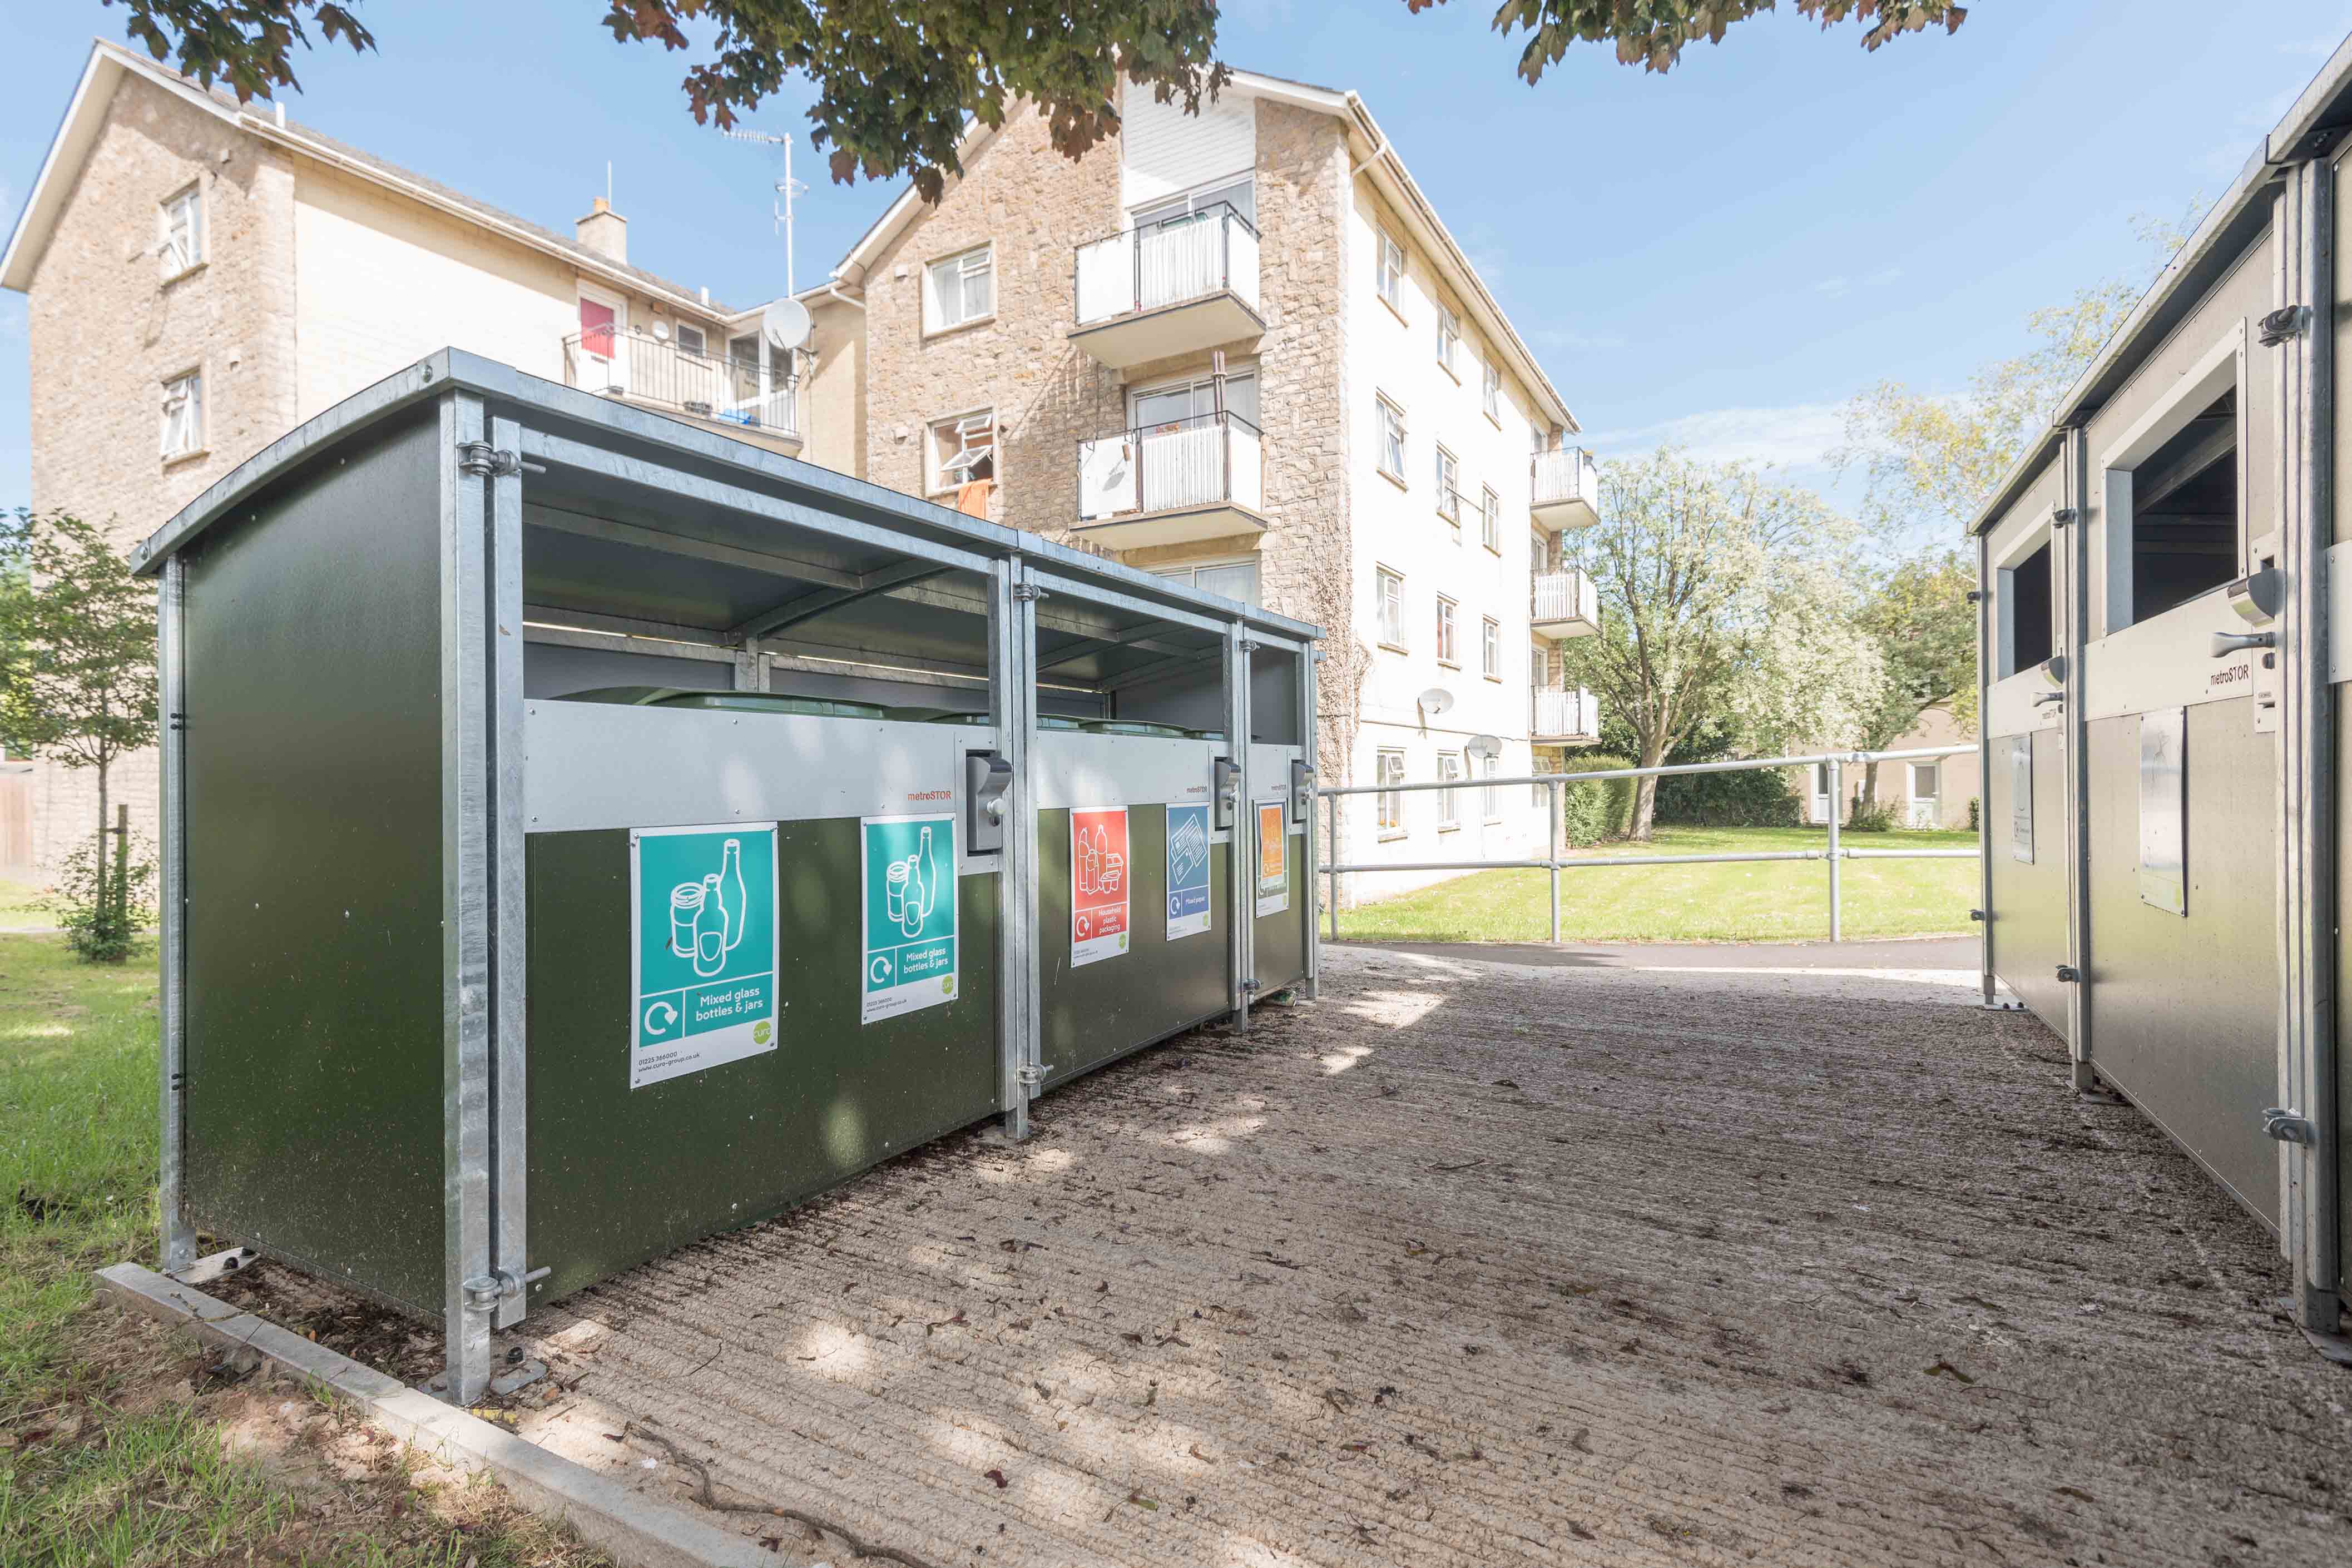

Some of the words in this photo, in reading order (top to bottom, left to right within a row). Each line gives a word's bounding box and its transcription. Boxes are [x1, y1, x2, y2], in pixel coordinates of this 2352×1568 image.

[2211, 664, 2249, 686] metroSTOR
[908, 790, 952, 801] metroSTOR
[1103, 916, 1117, 925] plastic
[1099, 924, 1121, 934] packaging
[906, 950, 927, 962] Mixed
[929, 947, 946, 958] glass
[903, 961, 928, 974] bottles
[929, 960, 935, 968] &
[935, 957, 948, 969] jars
[700, 990, 732, 1008] Mixed
[734, 988, 760, 1002] glass
[696, 1005, 733, 1021] bottles
[735, 1002, 743, 1013] &
[744, 1000, 764, 1014] jars
[638, 1056, 655, 1066] 01225
[656, 1051, 678, 1061] 366000
[638, 1052, 700, 1072] www.curo-group.co.uk
